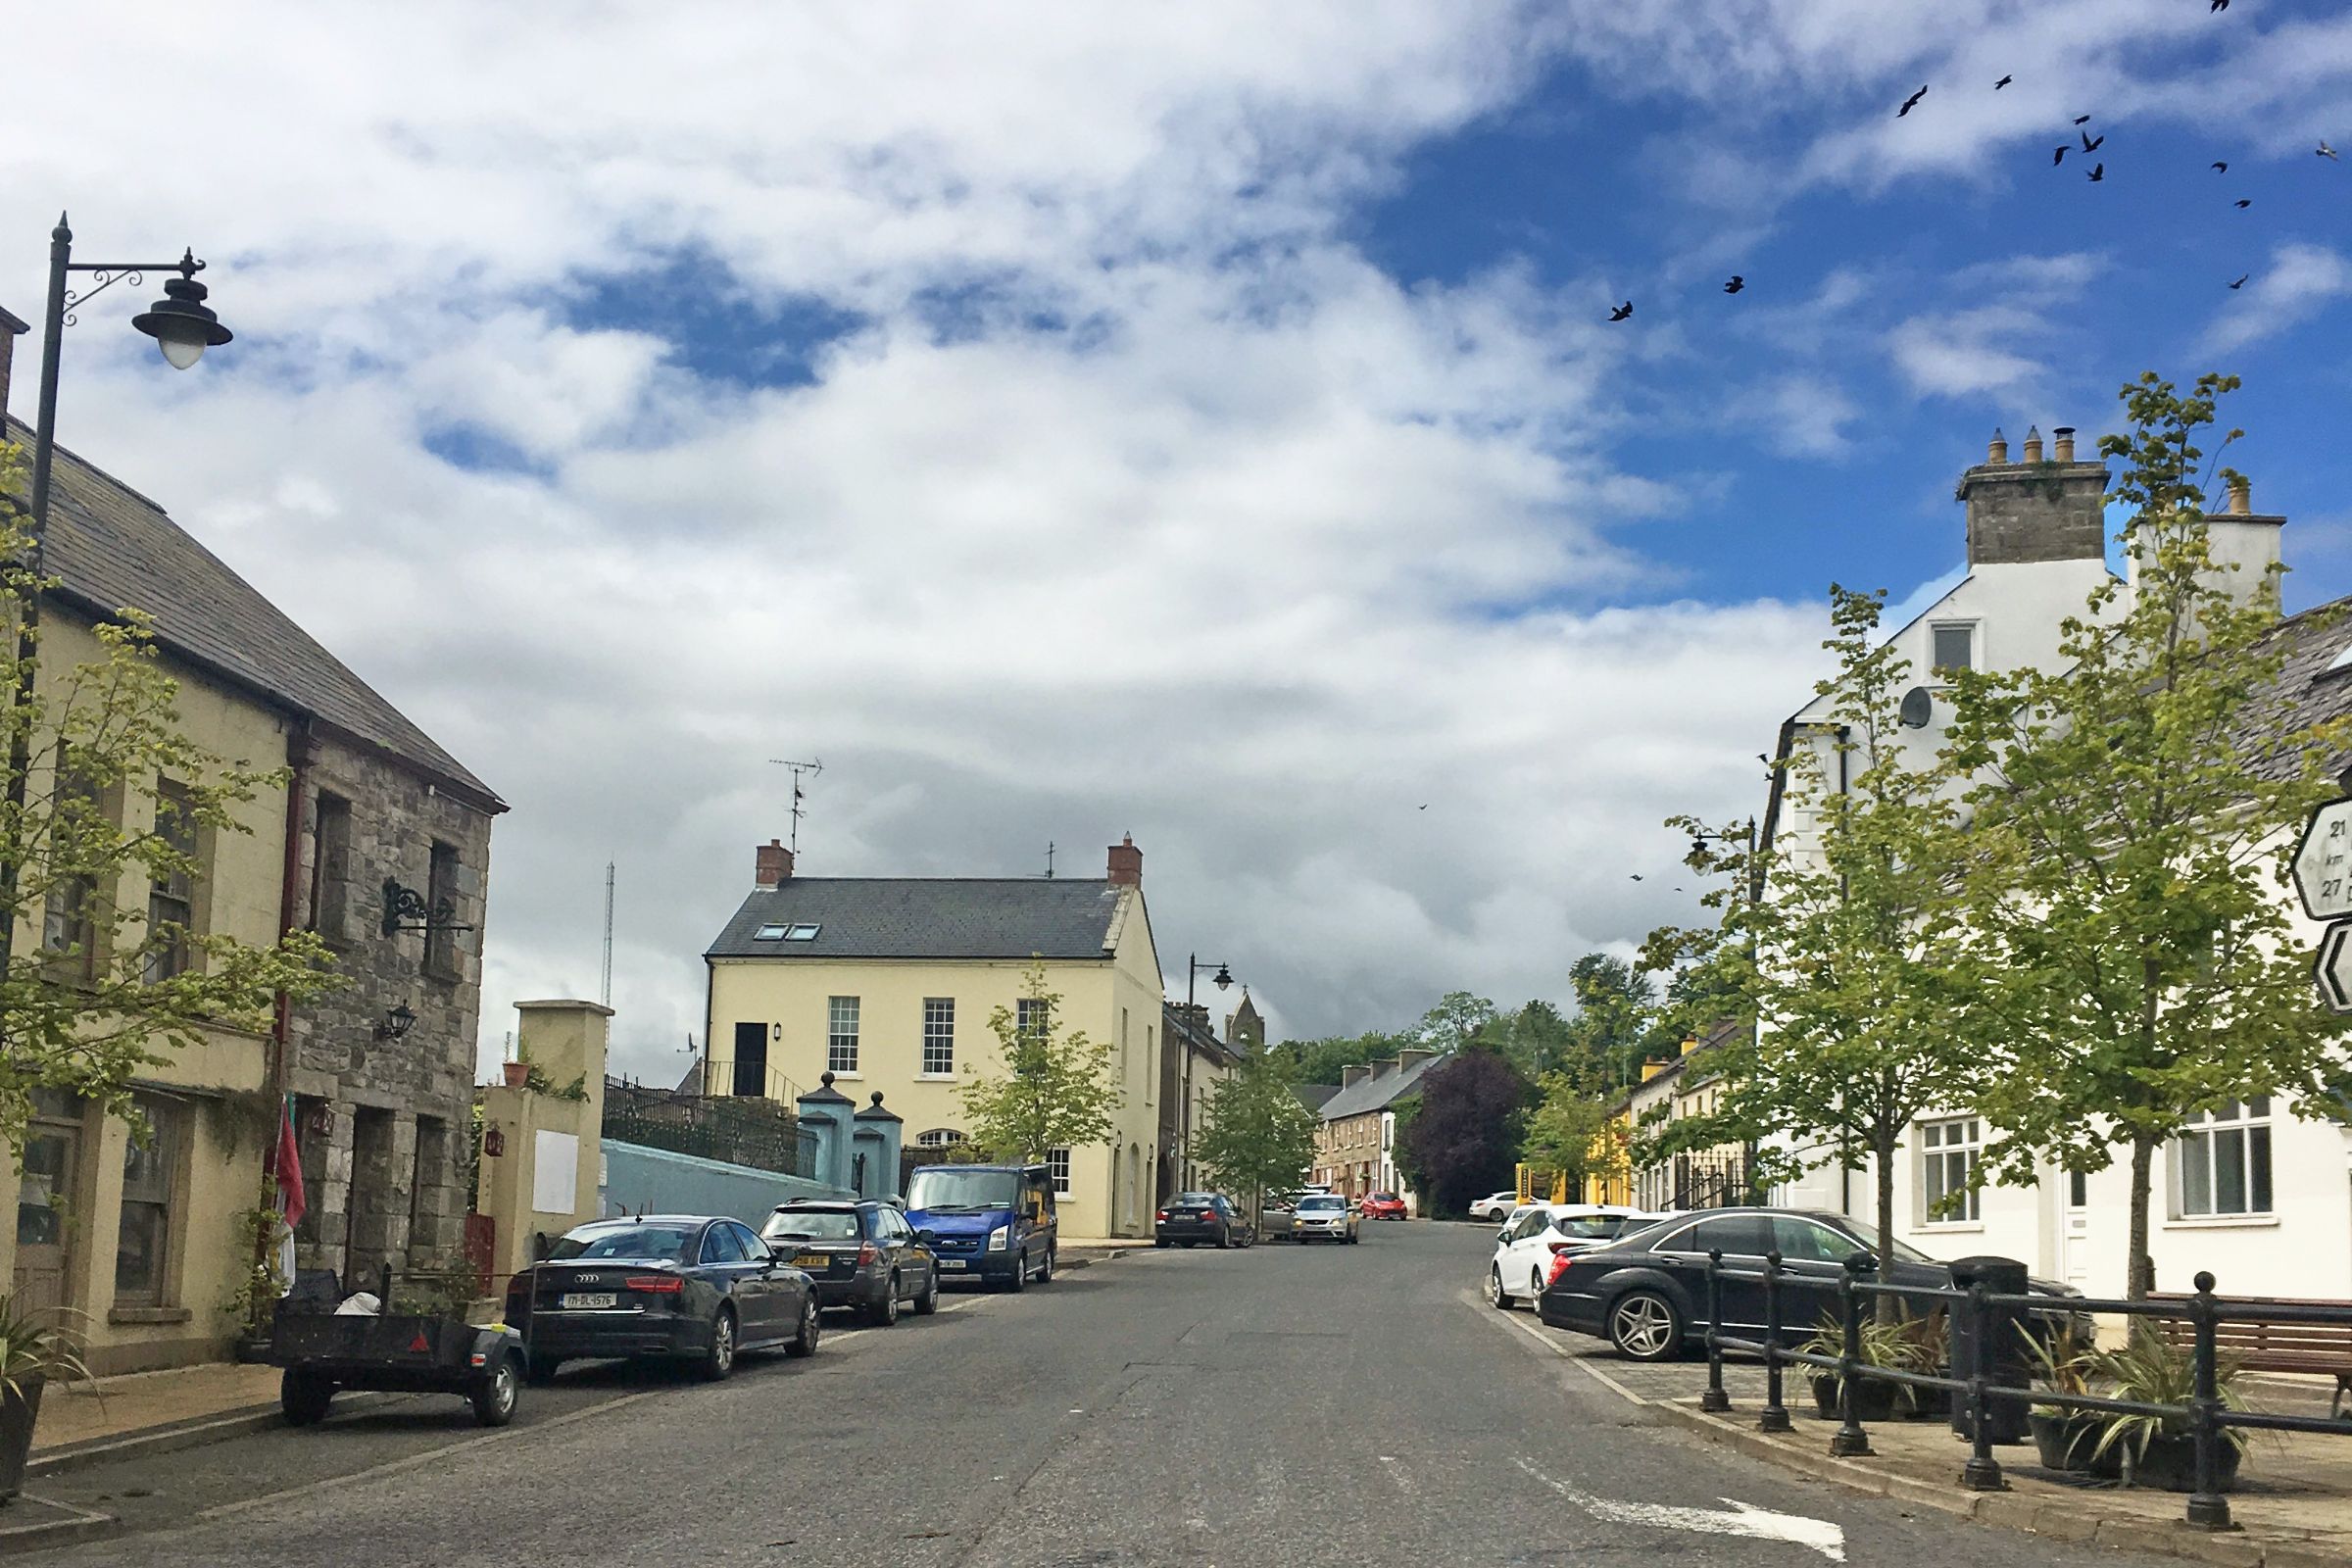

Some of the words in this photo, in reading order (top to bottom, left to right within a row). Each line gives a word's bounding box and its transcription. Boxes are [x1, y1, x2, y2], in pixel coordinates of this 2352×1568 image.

[2330, 819, 2346, 838] 21
[2326, 855, 2343, 865] km
[2322, 879, 2342, 897] 27
